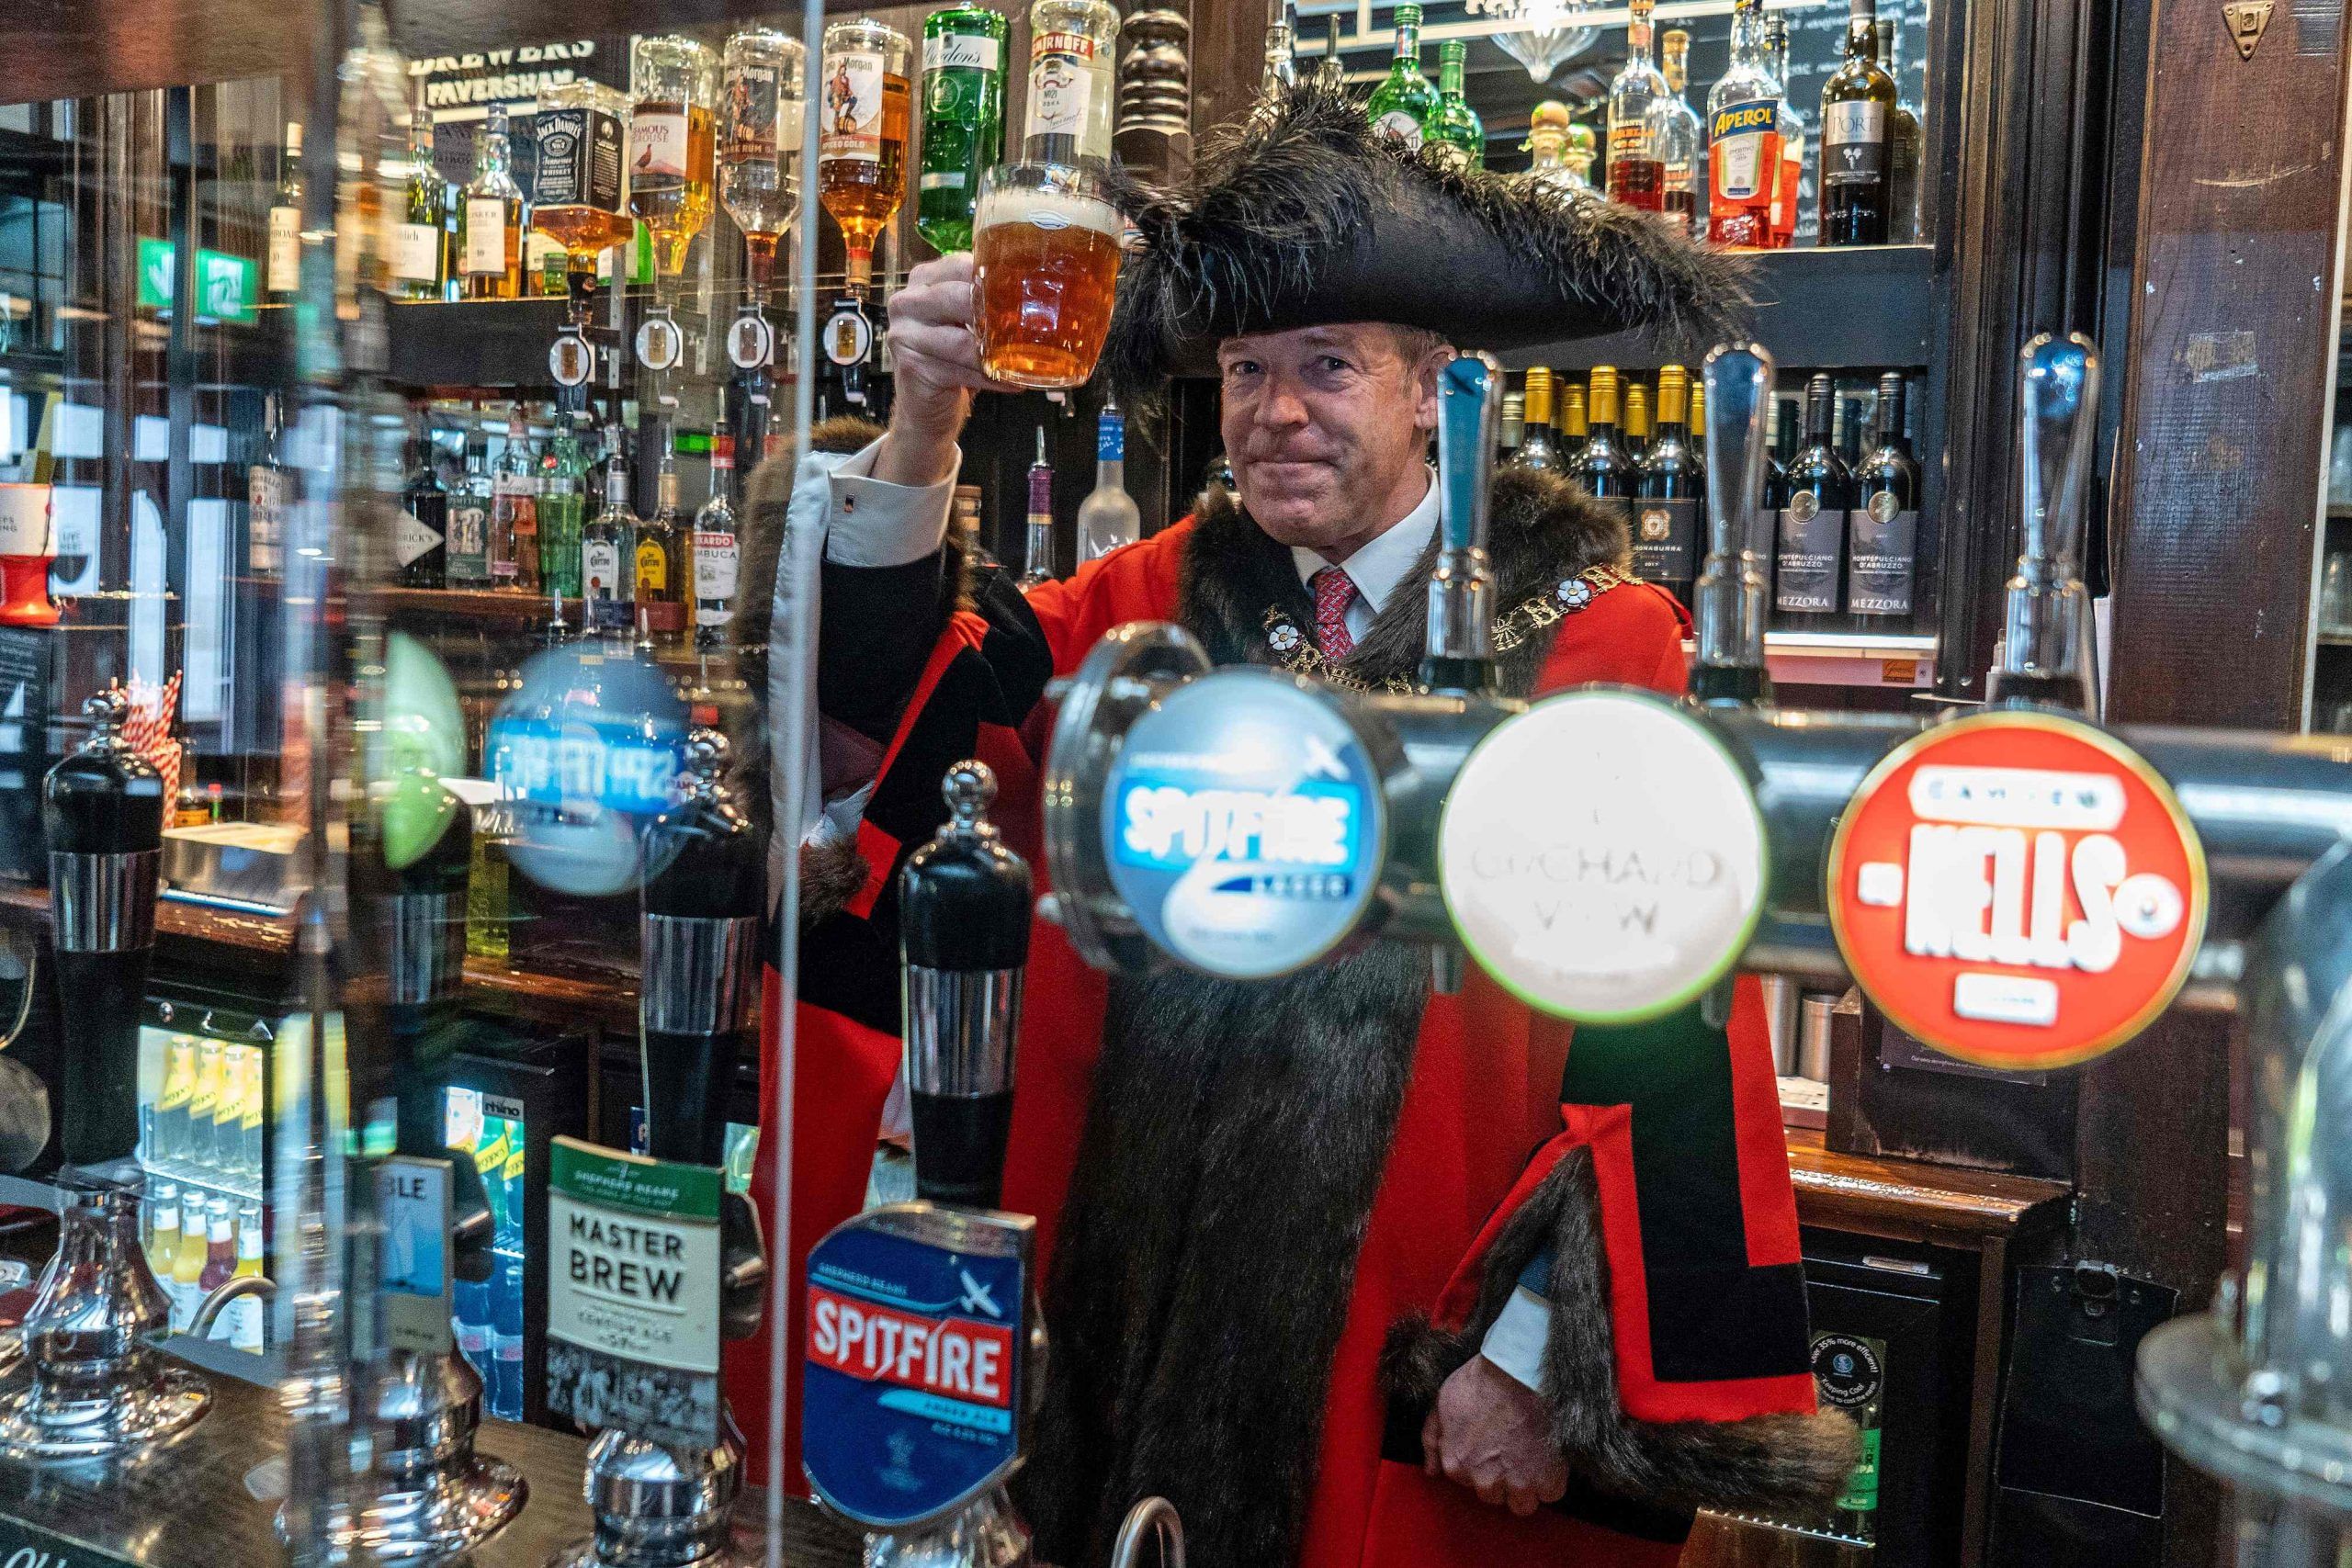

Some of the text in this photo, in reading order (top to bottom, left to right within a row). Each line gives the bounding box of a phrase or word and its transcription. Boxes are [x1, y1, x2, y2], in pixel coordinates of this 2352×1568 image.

[924, 43, 981, 66] Godon's
[426, 68, 574, 106] FAVERSHAM
[742, 65, 774, 84] Morgan
[1714, 107, 1773, 137] APEROL
[1832, 116, 1878, 133] PORT
[1778, 596, 1828, 607] MEZZORA
[1850, 597, 1908, 610] MEZZORA
[1124, 786, 1349, 863] SPITFIRE
[1471, 844, 1723, 887] OCHAD
[1534, 899, 1660, 936] VW
[570, 1213, 684, 1262] MASTER
[571, 1250, 684, 1304] BREW
[814, 1297, 1002, 1399] SPITFIRE
[1818, 1337, 1836, 1350] 35%
[1837, 1338, 1856, 1348] more
